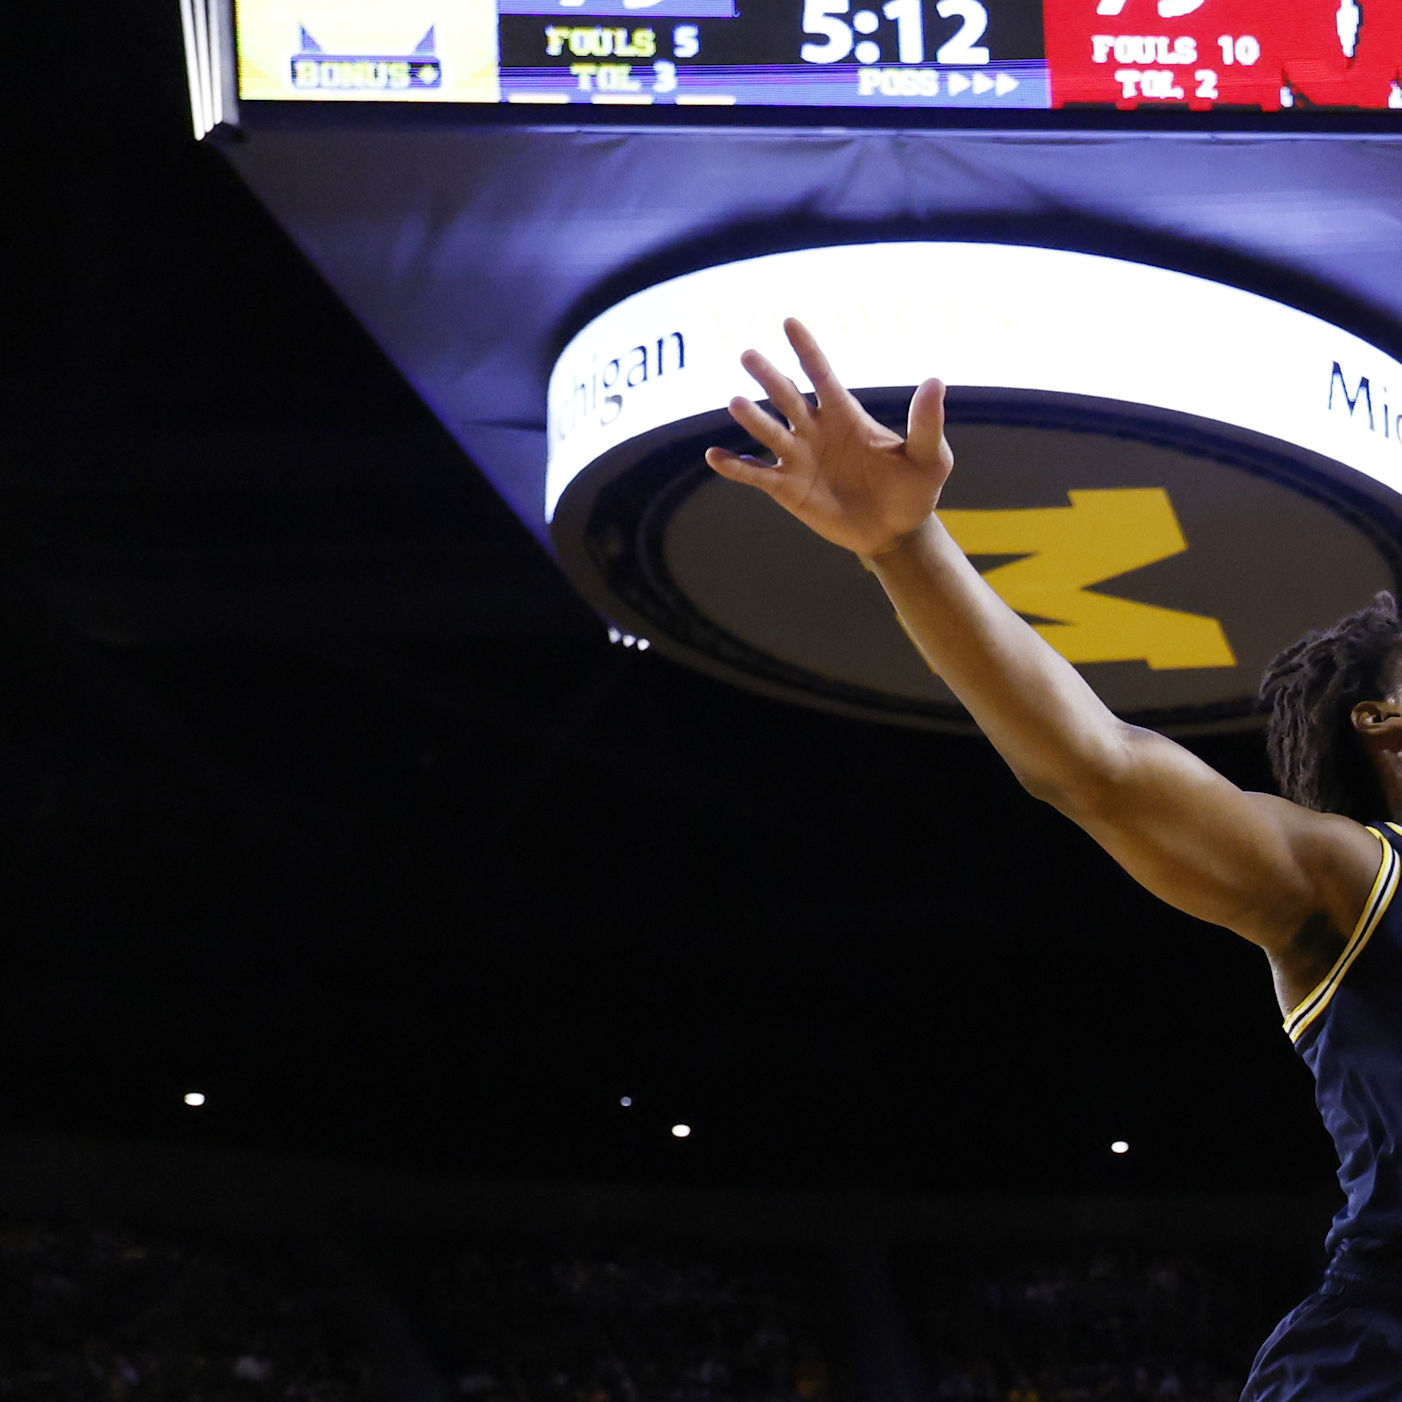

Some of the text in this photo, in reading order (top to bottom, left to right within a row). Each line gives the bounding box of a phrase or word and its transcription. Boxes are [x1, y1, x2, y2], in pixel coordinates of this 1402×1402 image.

[545, 24, 699, 58] FOULS 5
[800, 0, 990, 64] 5:12
[1091, 35, 1260, 65] FOULS 10
[294, 61, 411, 88] BONUS
[569, 60, 678, 93] TOL 3
[857, 69, 939, 97] POSS
[1115, 69, 1218, 99] TOL 2
